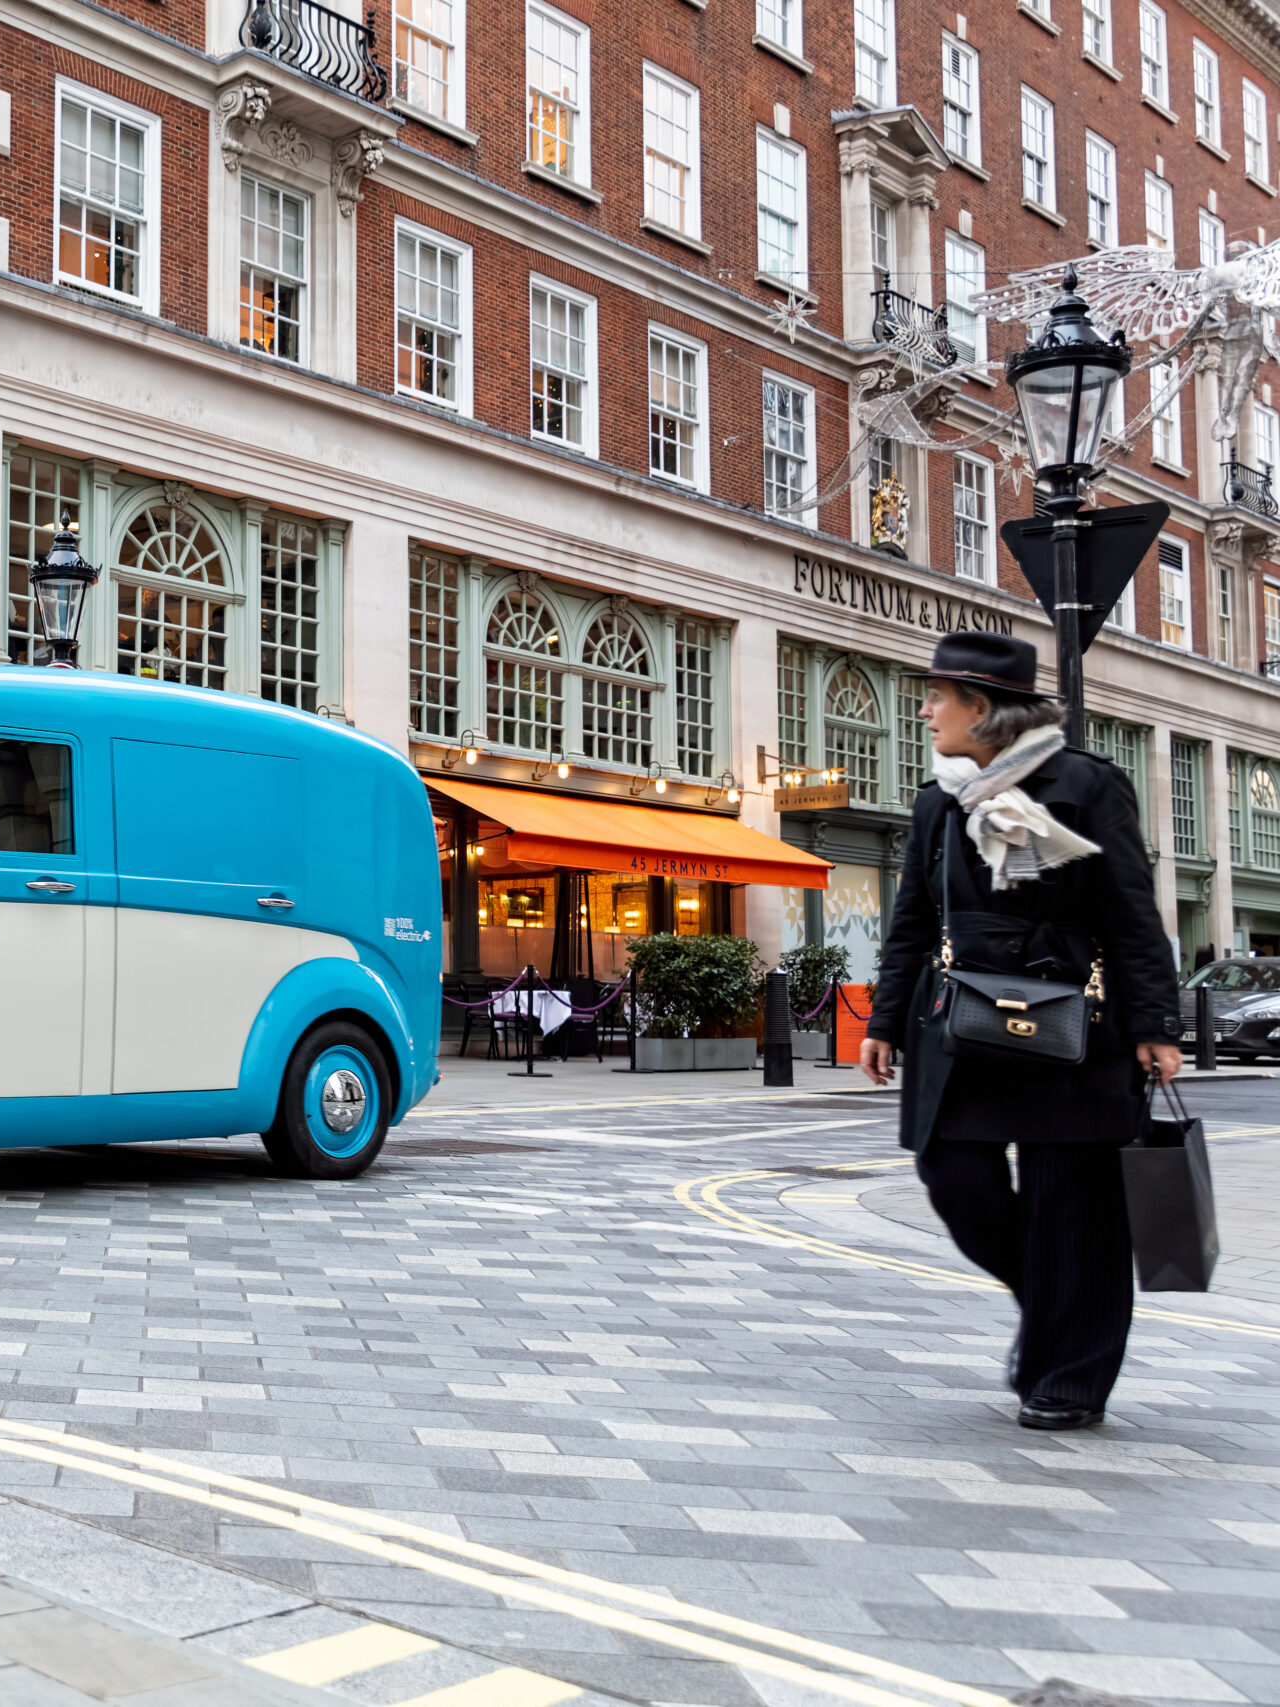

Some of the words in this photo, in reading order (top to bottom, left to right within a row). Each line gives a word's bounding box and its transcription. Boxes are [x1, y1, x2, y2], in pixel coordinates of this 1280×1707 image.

[793, 554, 915, 626] FORTNUM
[919, 599, 932, 629] &
[935, 596, 1013, 637] MASON
[793, 794, 828, 804] JERMYN
[631, 856, 646, 871] 45
[654, 858, 707, 877] JERMYN
[396, 917, 414, 930] 100%
[395, 929, 422, 942] electric
